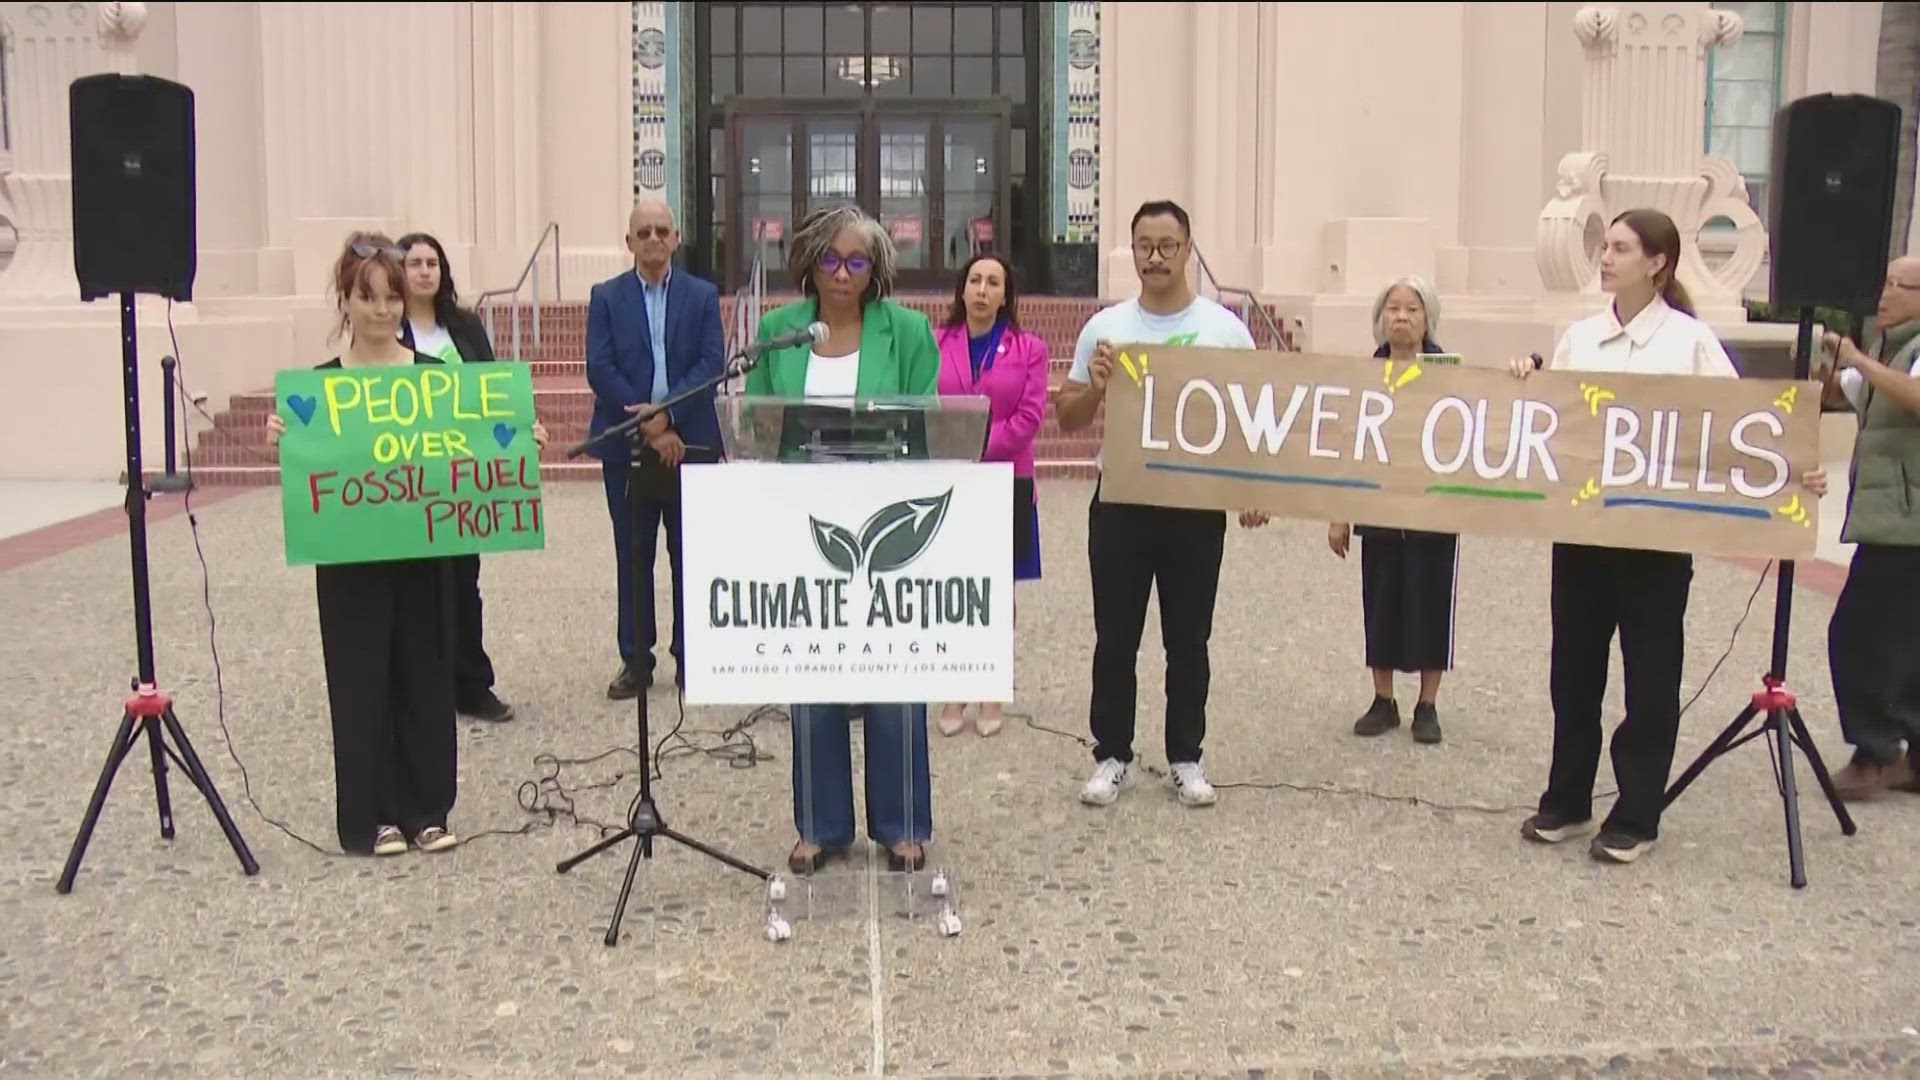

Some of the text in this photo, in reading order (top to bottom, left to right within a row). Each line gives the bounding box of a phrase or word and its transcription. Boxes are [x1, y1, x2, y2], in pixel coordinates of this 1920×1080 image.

[324, 369, 516, 436] PEOPLE
[373, 429, 474, 463] OVER
[1141, 375, 1790, 499] LOWER OUR BILLS
[309, 456, 539, 514] FOSSIL FUEL
[424, 498, 541, 544] PROFIT
[709, 576, 991, 629] CLIMATE ACTION
[712, 665, 735, 674] SAN
[741, 664, 779, 674] DIEGO
[795, 663, 842, 673] ORANGE
[850, 663, 899, 673] COUNTY
[914, 663, 935, 673] LOS
[941, 662, 995, 672] ANGELES
[756, 641, 947, 655] CAMPAIGN
